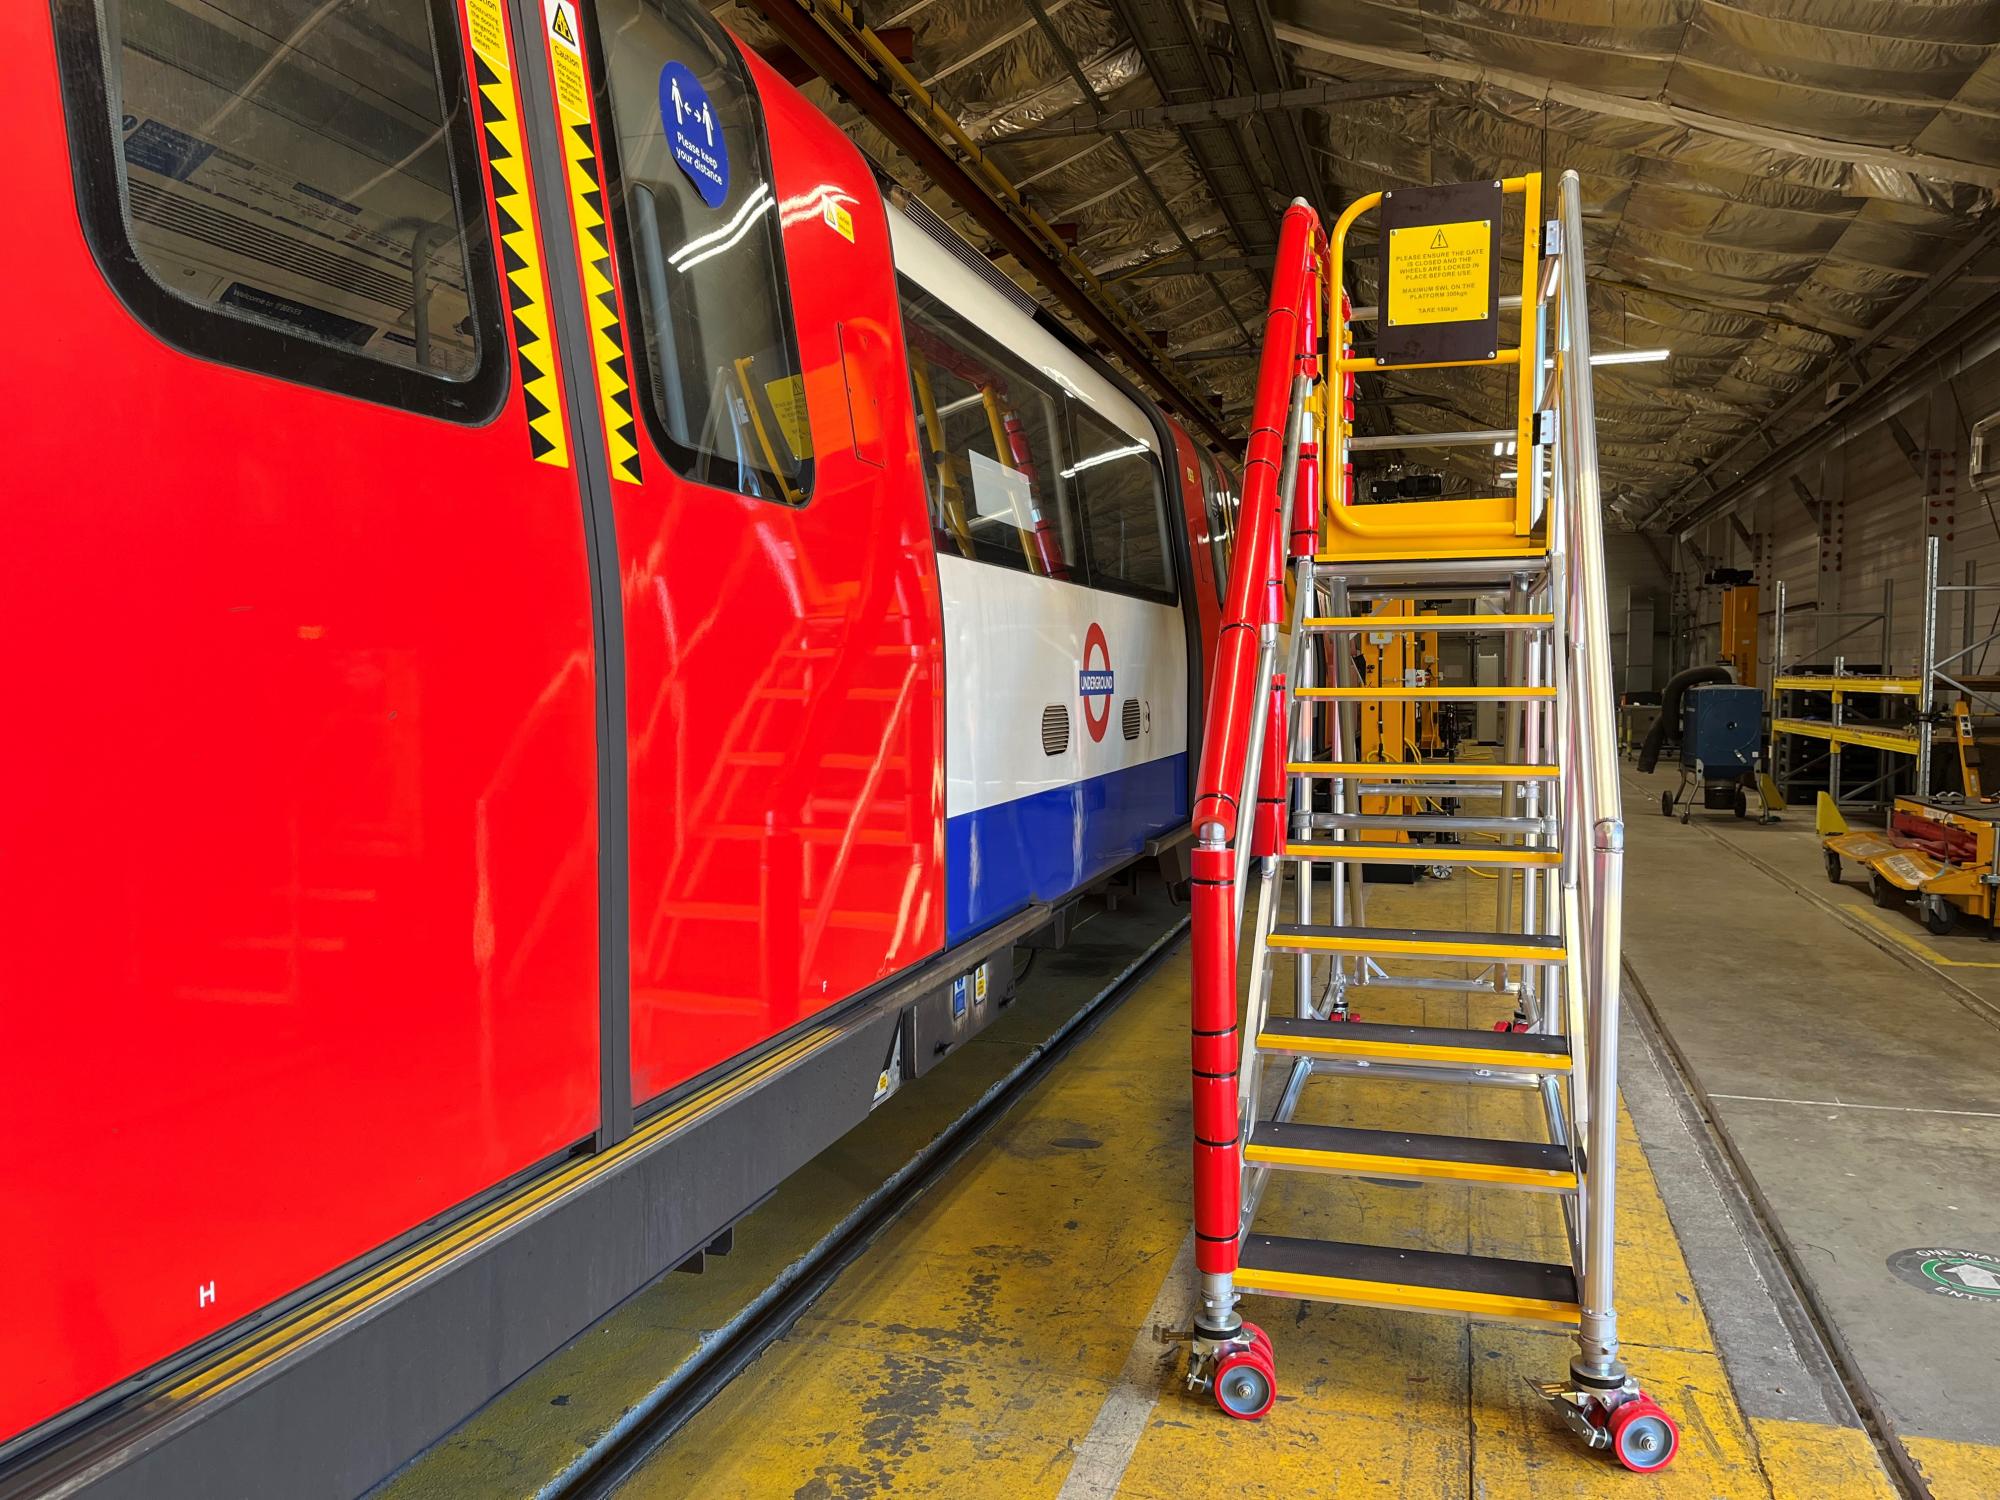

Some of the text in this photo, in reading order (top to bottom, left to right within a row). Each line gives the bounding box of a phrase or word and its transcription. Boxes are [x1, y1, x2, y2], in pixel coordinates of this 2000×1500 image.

[555, 45, 580, 70] Caution
[677, 131, 718, 170] Please keep
[676, 146, 723, 186] your distance
[1396, 254, 1420, 262] PLEASE
[1423, 251, 1450, 260] ENSURE
[1466, 248, 1484, 256] GATE
[1415, 259, 1442, 267] CLOSED
[1443, 263, 1471, 271] LOCKED
[1429, 271, 1455, 279] BEFORE
[1402, 286, 1434, 294] MAXIMUM
[1409, 292, 1445, 300] PLATFORM
[1081, 676, 1113, 690] UNDERGROUND
[199, 1280, 215, 1308] H
[1934, 1286, 2000, 1302] ENTR
